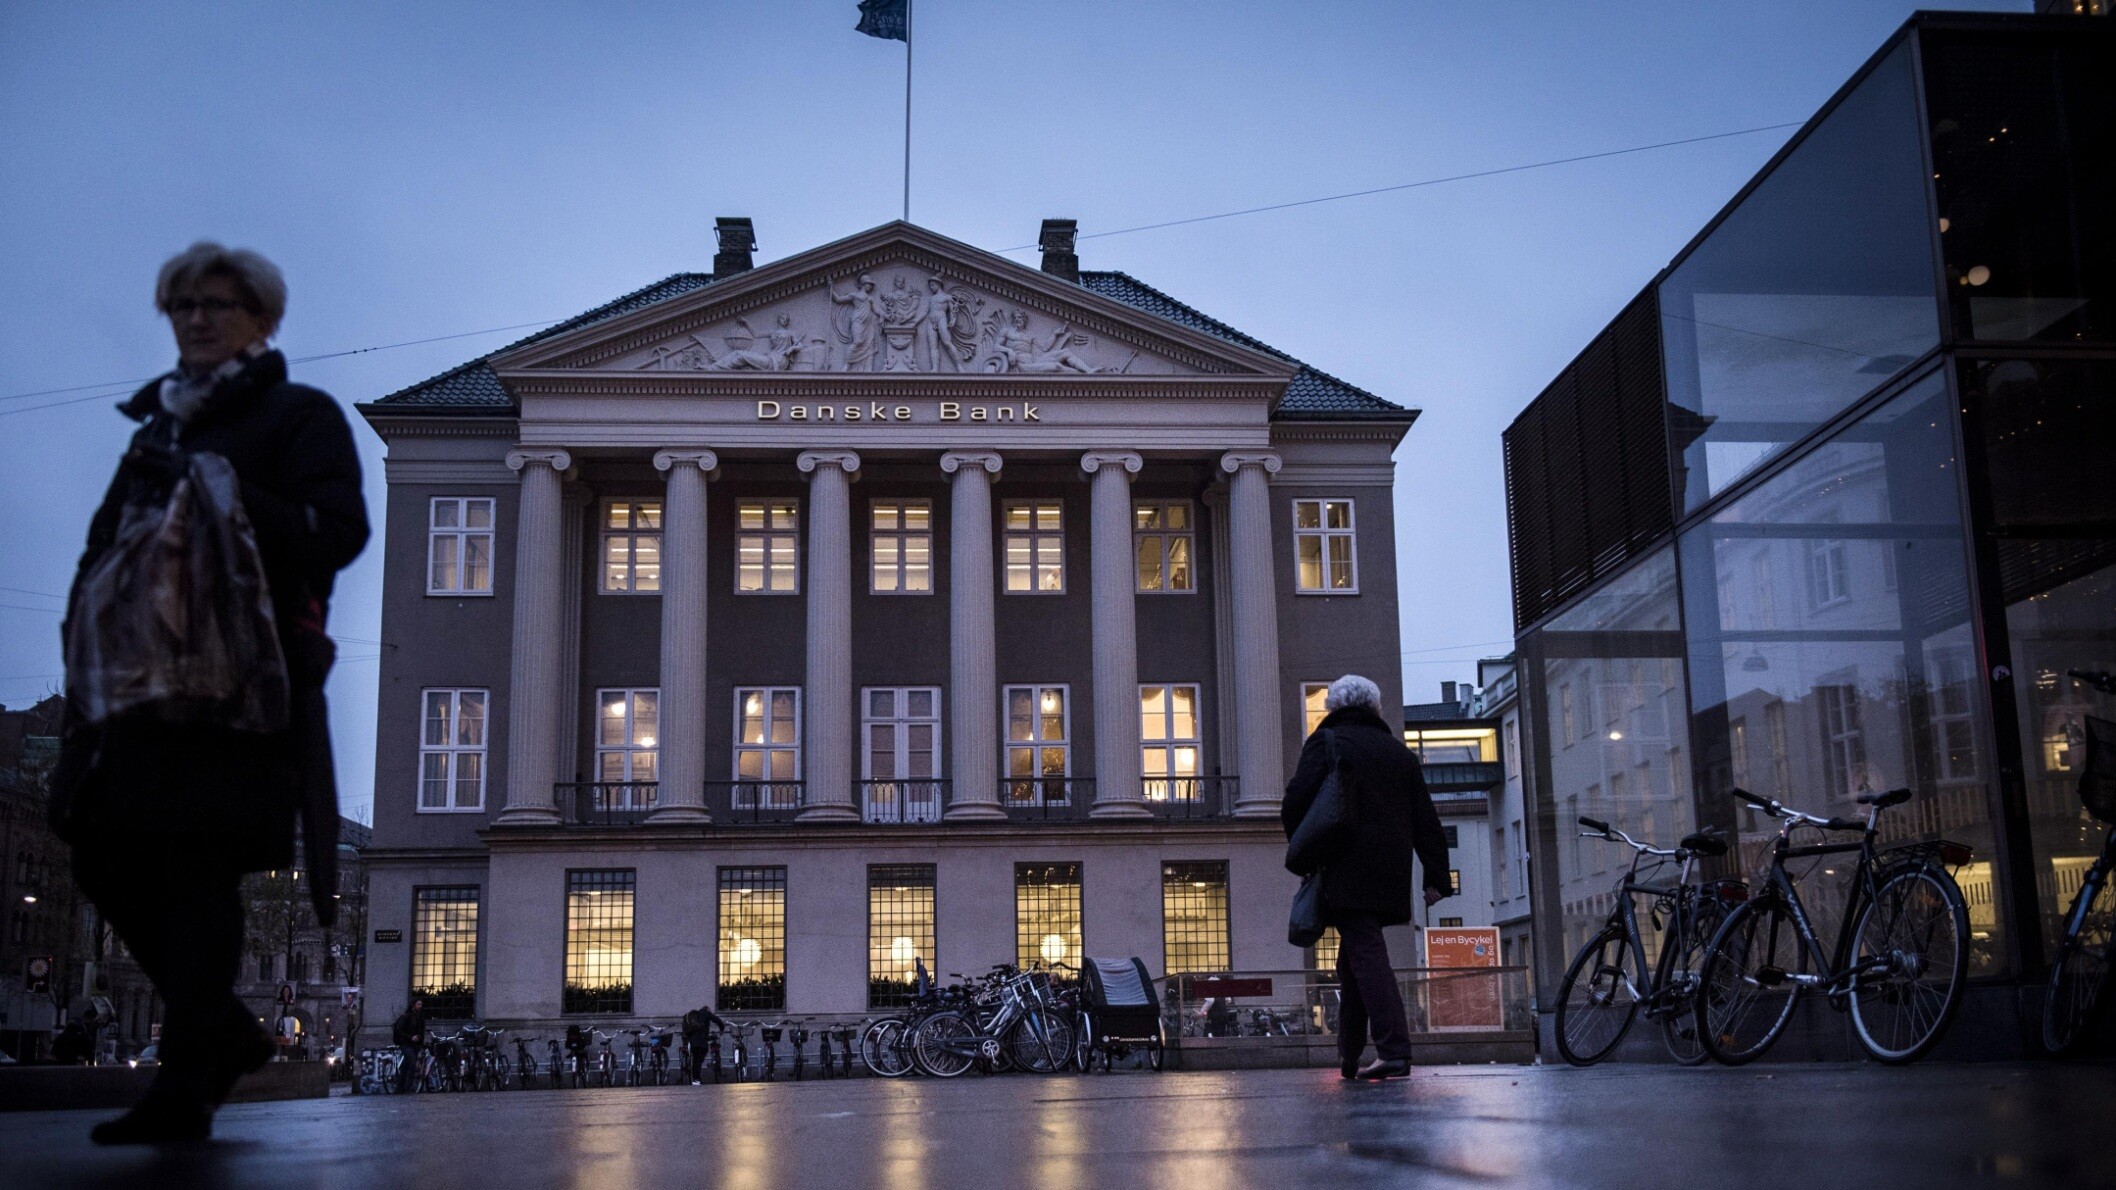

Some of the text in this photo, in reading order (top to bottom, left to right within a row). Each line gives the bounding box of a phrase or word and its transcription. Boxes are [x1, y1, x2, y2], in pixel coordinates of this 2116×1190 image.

[757, 401, 1040, 420] Danske Bank
[1430, 935, 1444, 945] Lej
[1457, 935, 1493, 945] Bycykel
[1487, 945, 1494, 956] og
